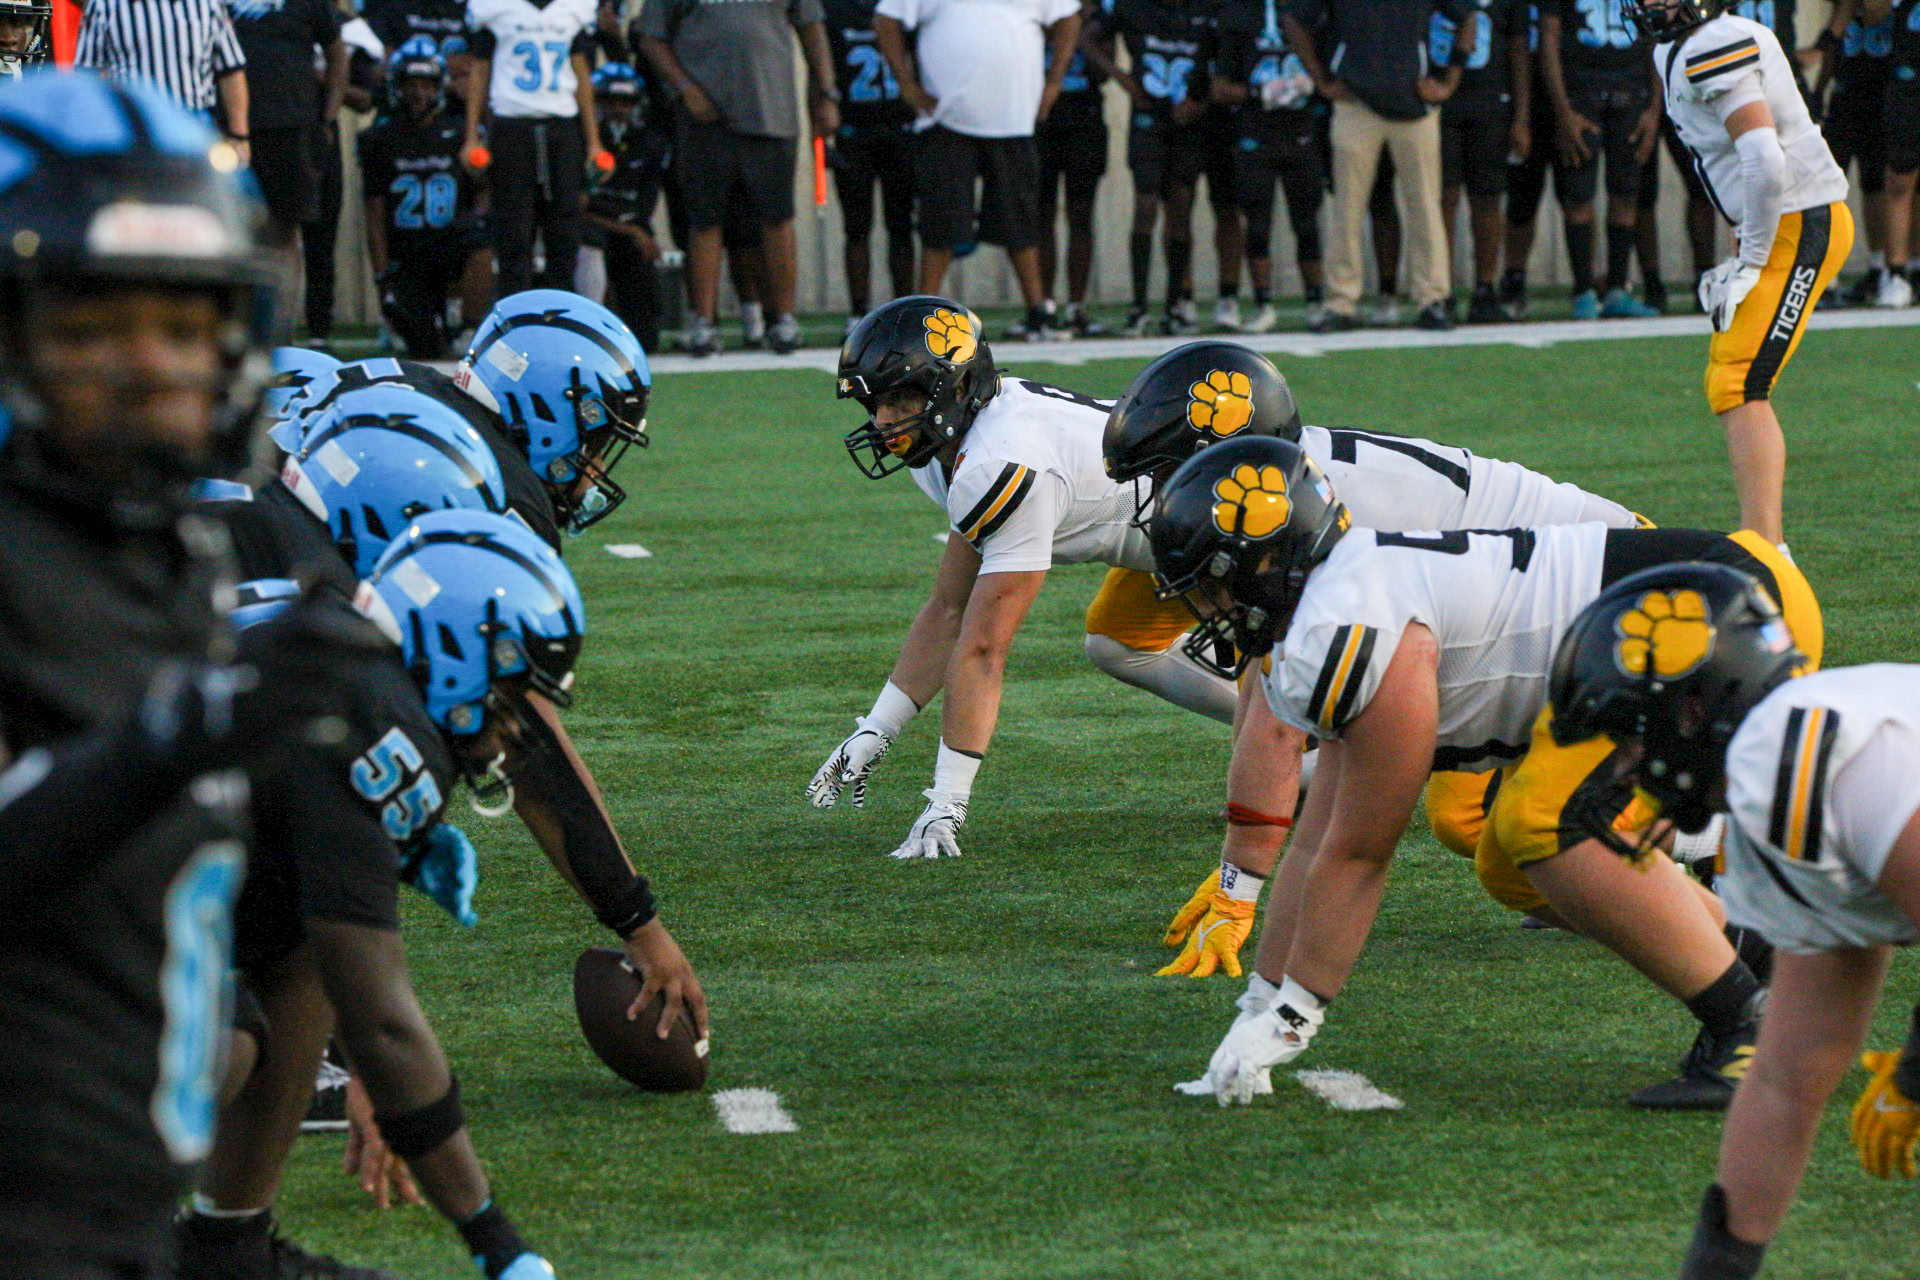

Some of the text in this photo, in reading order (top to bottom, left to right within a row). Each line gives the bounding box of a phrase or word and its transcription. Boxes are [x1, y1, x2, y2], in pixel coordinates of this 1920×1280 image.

[514, 40, 569, 92] 37
[390, 173, 458, 229] 28
[1769, 265, 1816, 340] TIGERS
[350, 726, 443, 841] 55
